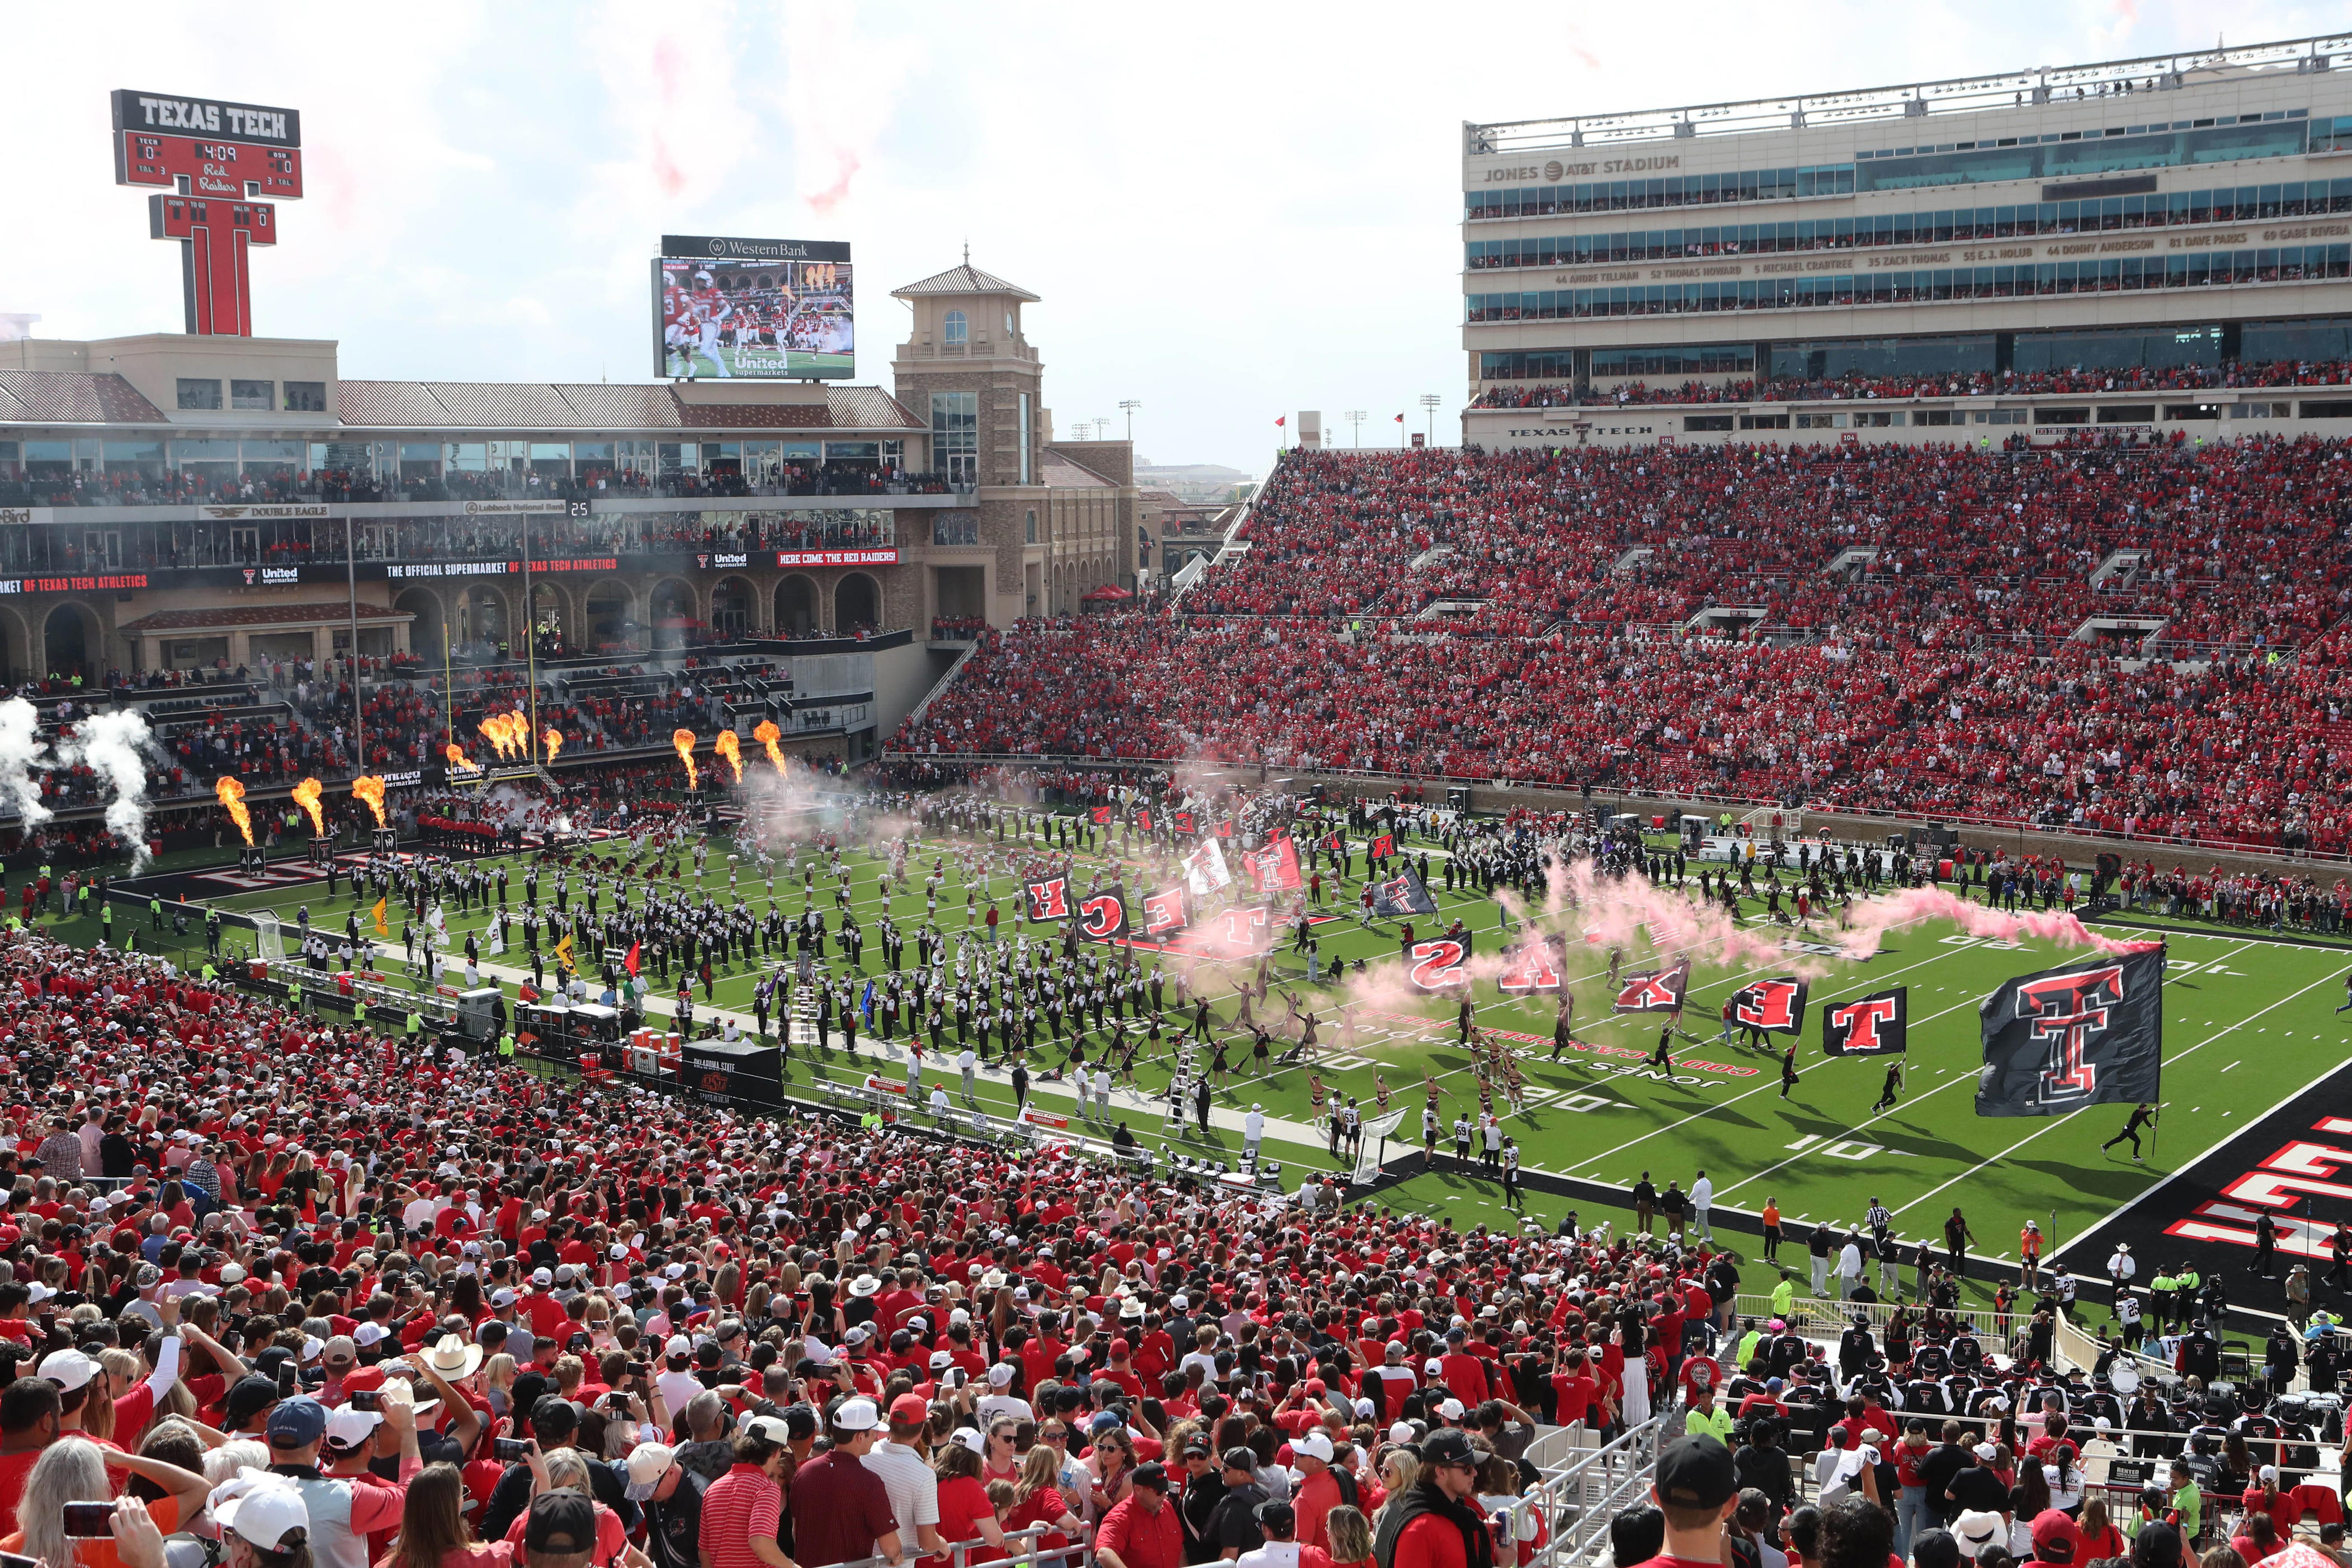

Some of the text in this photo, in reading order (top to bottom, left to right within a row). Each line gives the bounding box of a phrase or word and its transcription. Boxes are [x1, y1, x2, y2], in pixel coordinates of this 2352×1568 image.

[139, 97, 286, 139] TEXAS TECH
[146, 146, 154, 160] 0
[205, 145, 236, 162] 4:09
[160, 166, 166, 175] 3
[204, 164, 229, 177] Red
[284, 160, 291, 173] 0
[1484, 155, 1679, 182] JONES AT&T STADIUM
[199, 177, 237, 192] Raiders
[267, 177, 272, 185] 3
[259, 214, 266, 226] 0
[2263, 225, 2350, 240] 69 GABE RIVERA
[2047, 239, 2154, 255] 44 DONNY ANDERSON
[2169, 233, 2247, 248] 81 DAVE PARKS
[729, 241, 807, 257] Western Bank
[1963, 252, 1975, 261] 55
[2000, 247, 2033, 258] HOLUB
[1754, 259, 1853, 273] 5 MICHAEL CRABTREE
[1868, 253, 1950, 267] 35 ZACH THOMAS
[1570, 273, 1598, 284] ANDRE
[1601, 271, 1638, 282] TILLMAN
[1650, 266, 1741, 279] 52 THOMAS HOWARD
[735, 357, 787, 369] United
[1508, 426, 1652, 437] TEXAS TECH
[252, 506, 328, 517] DOUBLE EAGLE
[478, 502, 566, 512] Lubbock National Bank
[571, 502, 588, 517] 25
[715, 552, 747, 564] United
[780, 551, 896, 565] HERE COME THE RED RAIDERS!
[262, 568, 298, 579] United
[387, 565, 403, 578] THE
[405, 564, 443, 577] OFFICIAL
[445, 561, 507, 575] SUPERMARKET
[509, 561, 519, 573] OF
[550, 560, 570, 572] TECH
[573, 558, 617, 571] ATHLETICS
[23, 579, 35, 592] OF
[39, 577, 68, 592] TEXAS
[71, 576, 95, 590] TECH
[98, 574, 148, 589] ATHLETICS
[694, 1058, 735, 1073] OKLAHOMA STATE
[876, 1081, 895, 1090] GATORADE
[1033, 1116, 1055, 1125] GATORADE
[1344, 1113, 1354, 1123] 53
[1457, 1126, 1467, 1136] 59
[1510, 1152, 1518, 1164] 90
[2064, 1280, 2074, 1292] 27
[2127, 1303, 2139, 1317] 25
[2188, 1461, 2212, 1473] MAHOMES
